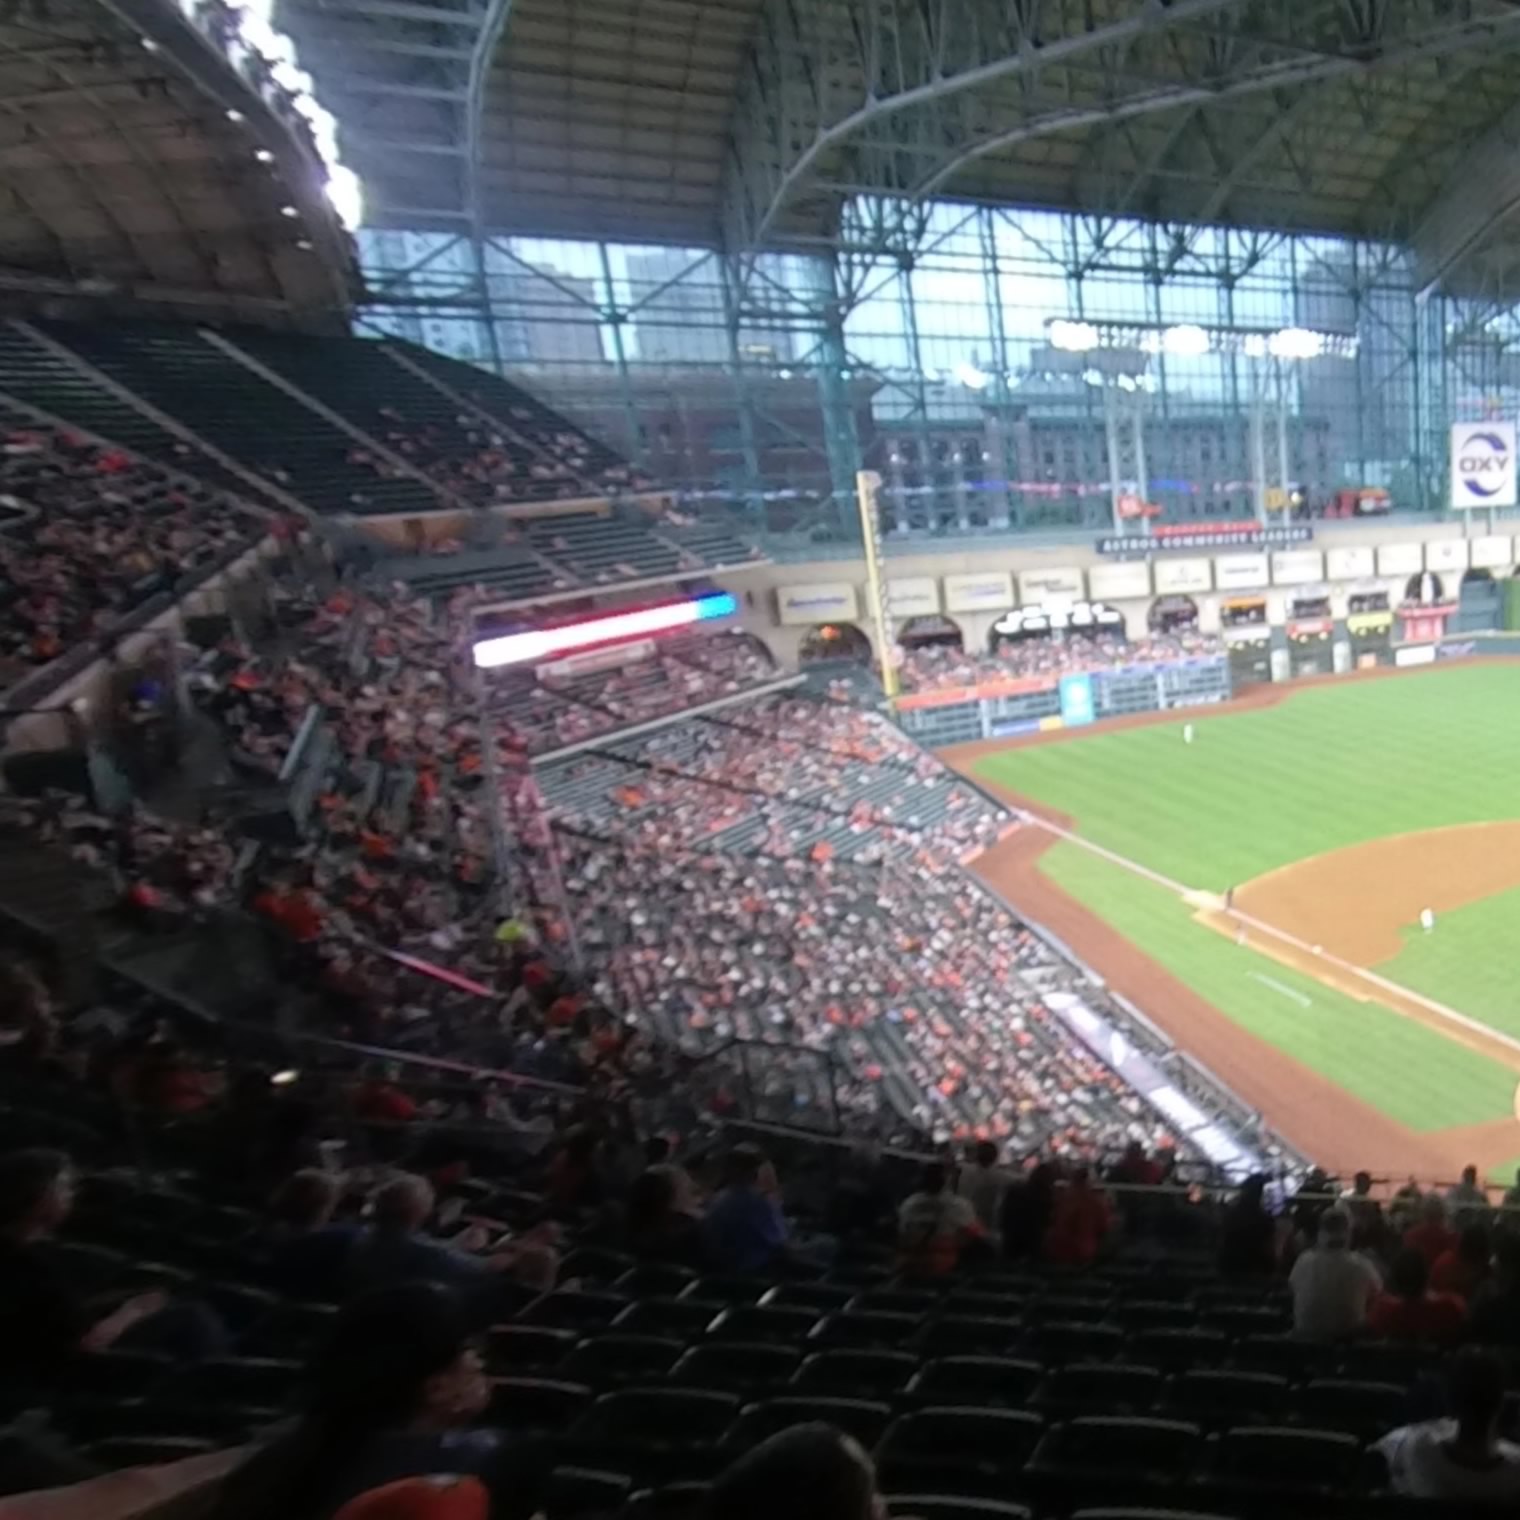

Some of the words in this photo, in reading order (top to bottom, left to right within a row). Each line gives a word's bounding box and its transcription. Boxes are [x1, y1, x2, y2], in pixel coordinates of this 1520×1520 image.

[1459, 455, 1509, 473] OXY
[1102, 537, 1159, 551] ASTROS
[1162, 532, 1248, 548] COMMUNITY
